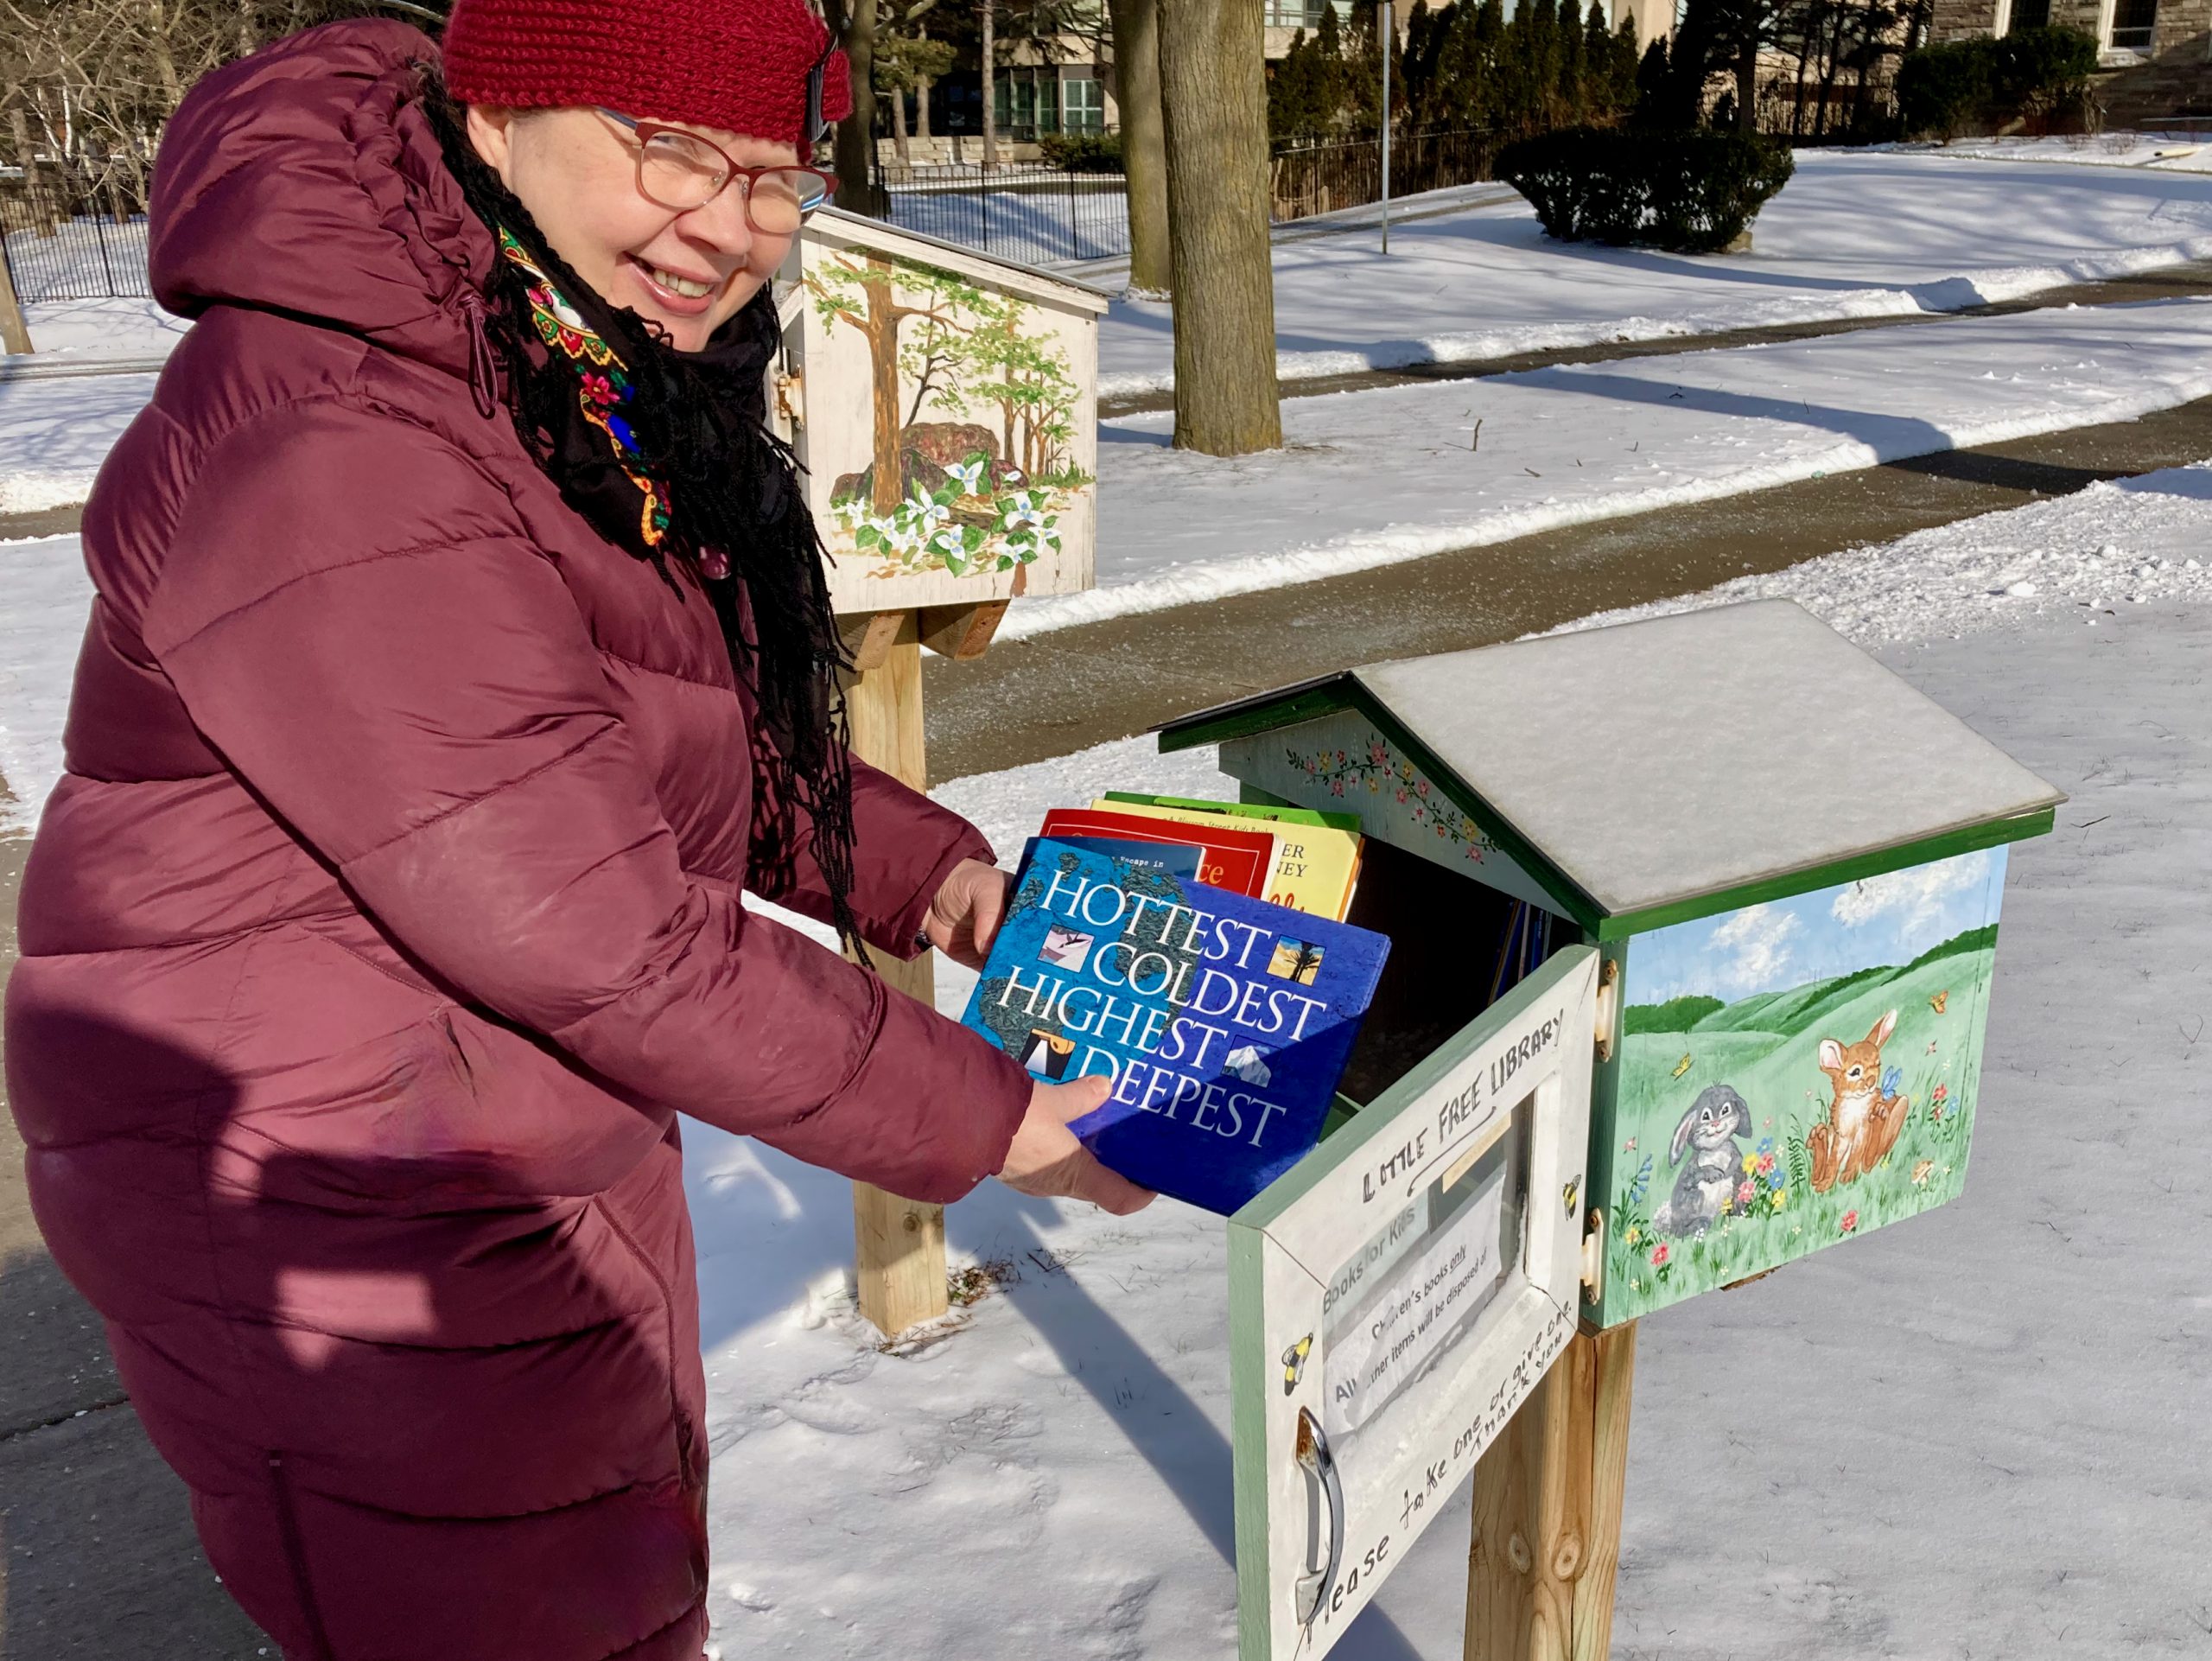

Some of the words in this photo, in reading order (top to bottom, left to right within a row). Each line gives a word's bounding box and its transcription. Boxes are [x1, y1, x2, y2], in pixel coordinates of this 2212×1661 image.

[1208, 821, 1230, 830] Street
[1039, 869, 1272, 970] HOTTEST
[996, 964, 1228, 1070] HIGHEST
[1092, 940, 1327, 1042] COLDEST
[1077, 1045, 1287, 1149] DEEPEST
[1363, 1128, 1428, 1203] LITTLE
[1439, 1070, 1484, 1145] FREE
[1491, 1009, 1564, 1096] LIBRARY
[1323, 1261, 1363, 1315] Books
[1391, 1328, 1415, 1362] items
[1418, 1310, 1433, 1336] will
[1435, 1300, 1445, 1318] be
[1446, 1258, 1479, 1305] disposed
[1480, 1246, 1487, 1266] of
[1424, 1266, 1448, 1298] books
[1449, 1244, 1466, 1274] only
[1535, 1332, 1562, 1375] you
[1400, 1460, 1446, 1530] take
[1453, 1415, 1481, 1460] one
[1489, 1378, 1508, 1411] or
[1512, 1332, 1542, 1391] give
